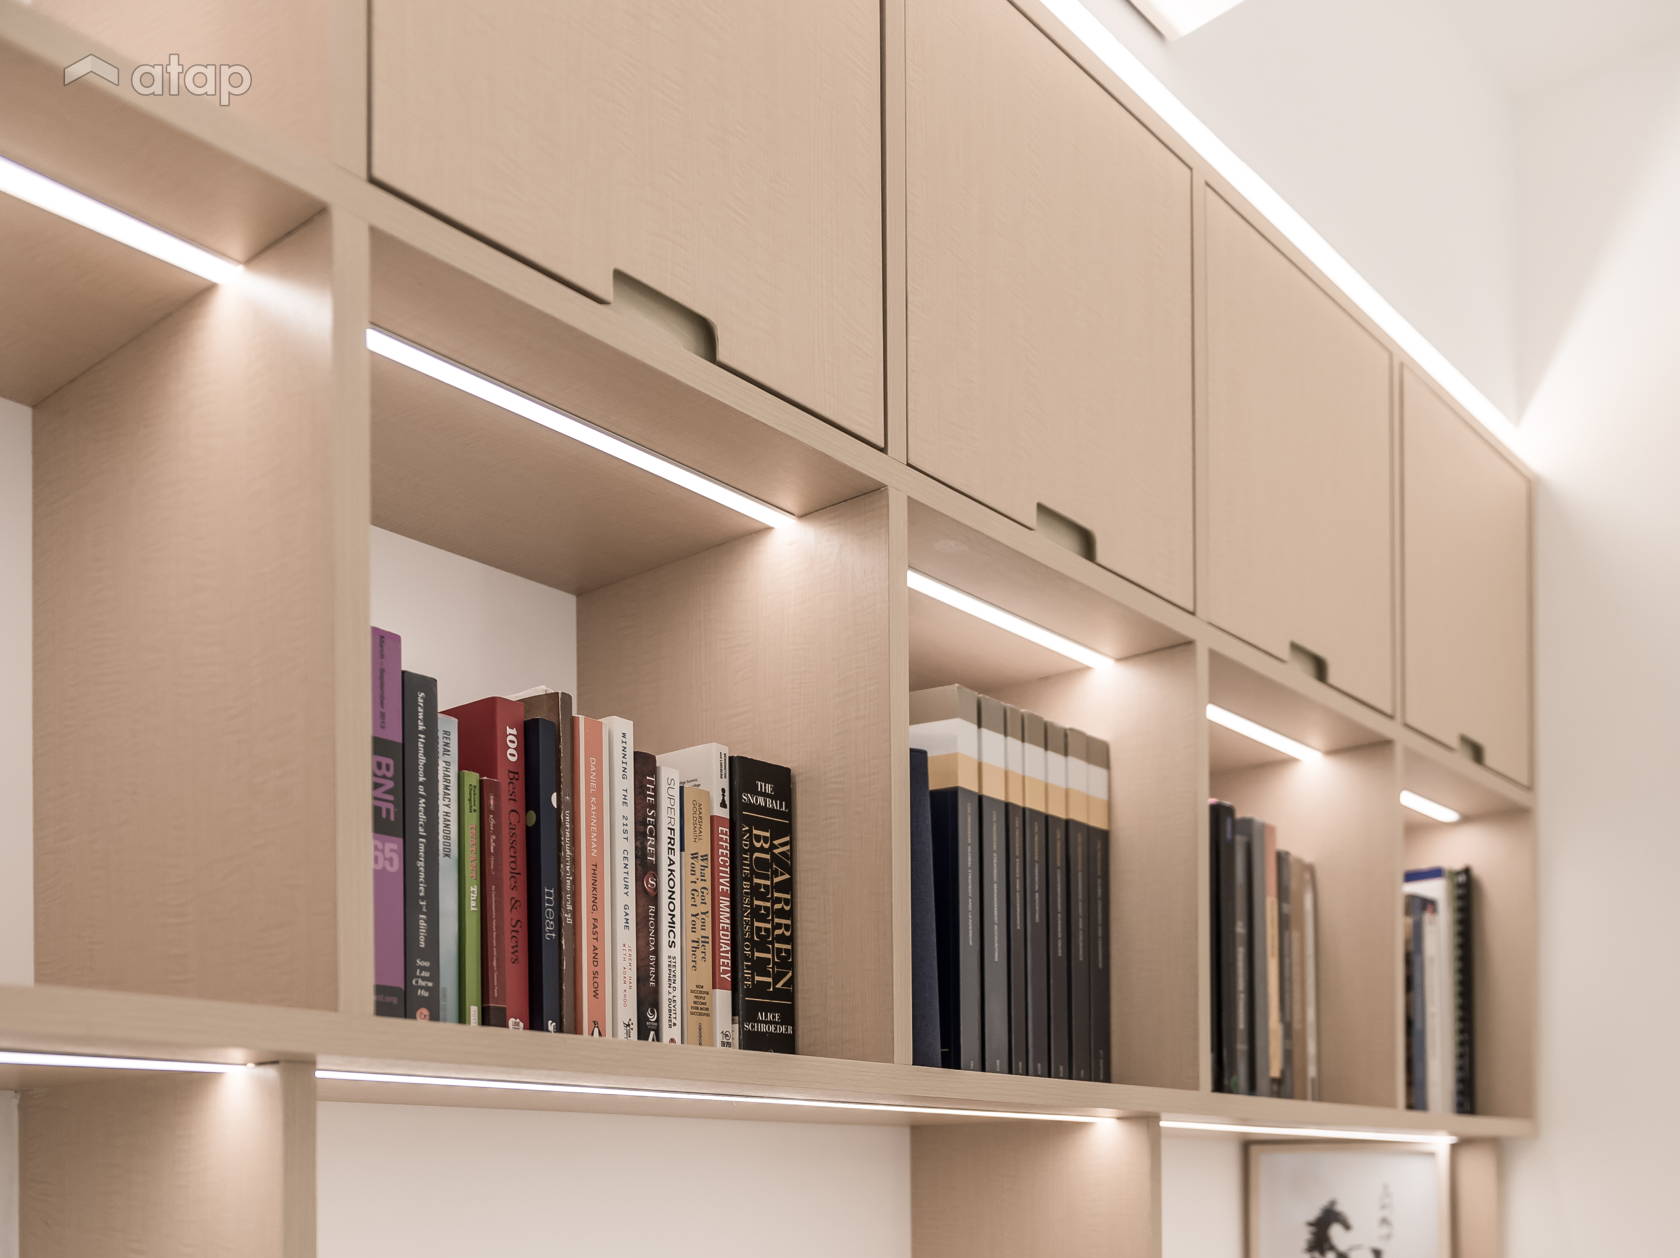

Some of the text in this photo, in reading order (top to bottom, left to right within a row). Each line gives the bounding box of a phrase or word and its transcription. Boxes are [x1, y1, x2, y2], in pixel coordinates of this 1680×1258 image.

[417, 692, 426, 731] Sarawak
[373, 754, 395, 821] BNF
[418, 734, 426, 782] Handbook
[756, 780, 774, 795] THE
[418, 784, 427, 797] of
[418, 798, 428, 836] Medical
[442, 730, 452, 859] RENAL PHARMACY HANDBOOK
[646, 774, 656, 864] THE SECRET
[742, 792, 788, 812] SNOWBALL
[415, 838, 427, 897] Emergencies
[506, 726, 522, 965] 100 Best Casseroles & Stews
[622, 849, 630, 897] CENTURY
[666, 776, 676, 950] SUPERFREAKONOMICS
[470, 885, 478, 912] Thai
[589, 756, 600, 1000] DANIEL KAHNEMAN THINKING, FAST AND SLOW
[700, 853, 710, 963] What Got You Here
[718, 826, 732, 982] EFFECTIVE IMMEDIATELY
[742, 824, 752, 989] AND THE BUSINESS OF LIFE
[752, 826, 772, 992] BUFFETT
[418, 914, 428, 949] Edition
[544, 887, 556, 941] meat
[690, 852, 700, 972] Won't Get You There
[772, 835, 793, 992] WARREN
[648, 904, 656, 988] RHONDA BYRNE
[744, 1022, 793, 1034] SCHROEDER
[756, 1012, 782, 1022] ALICE
